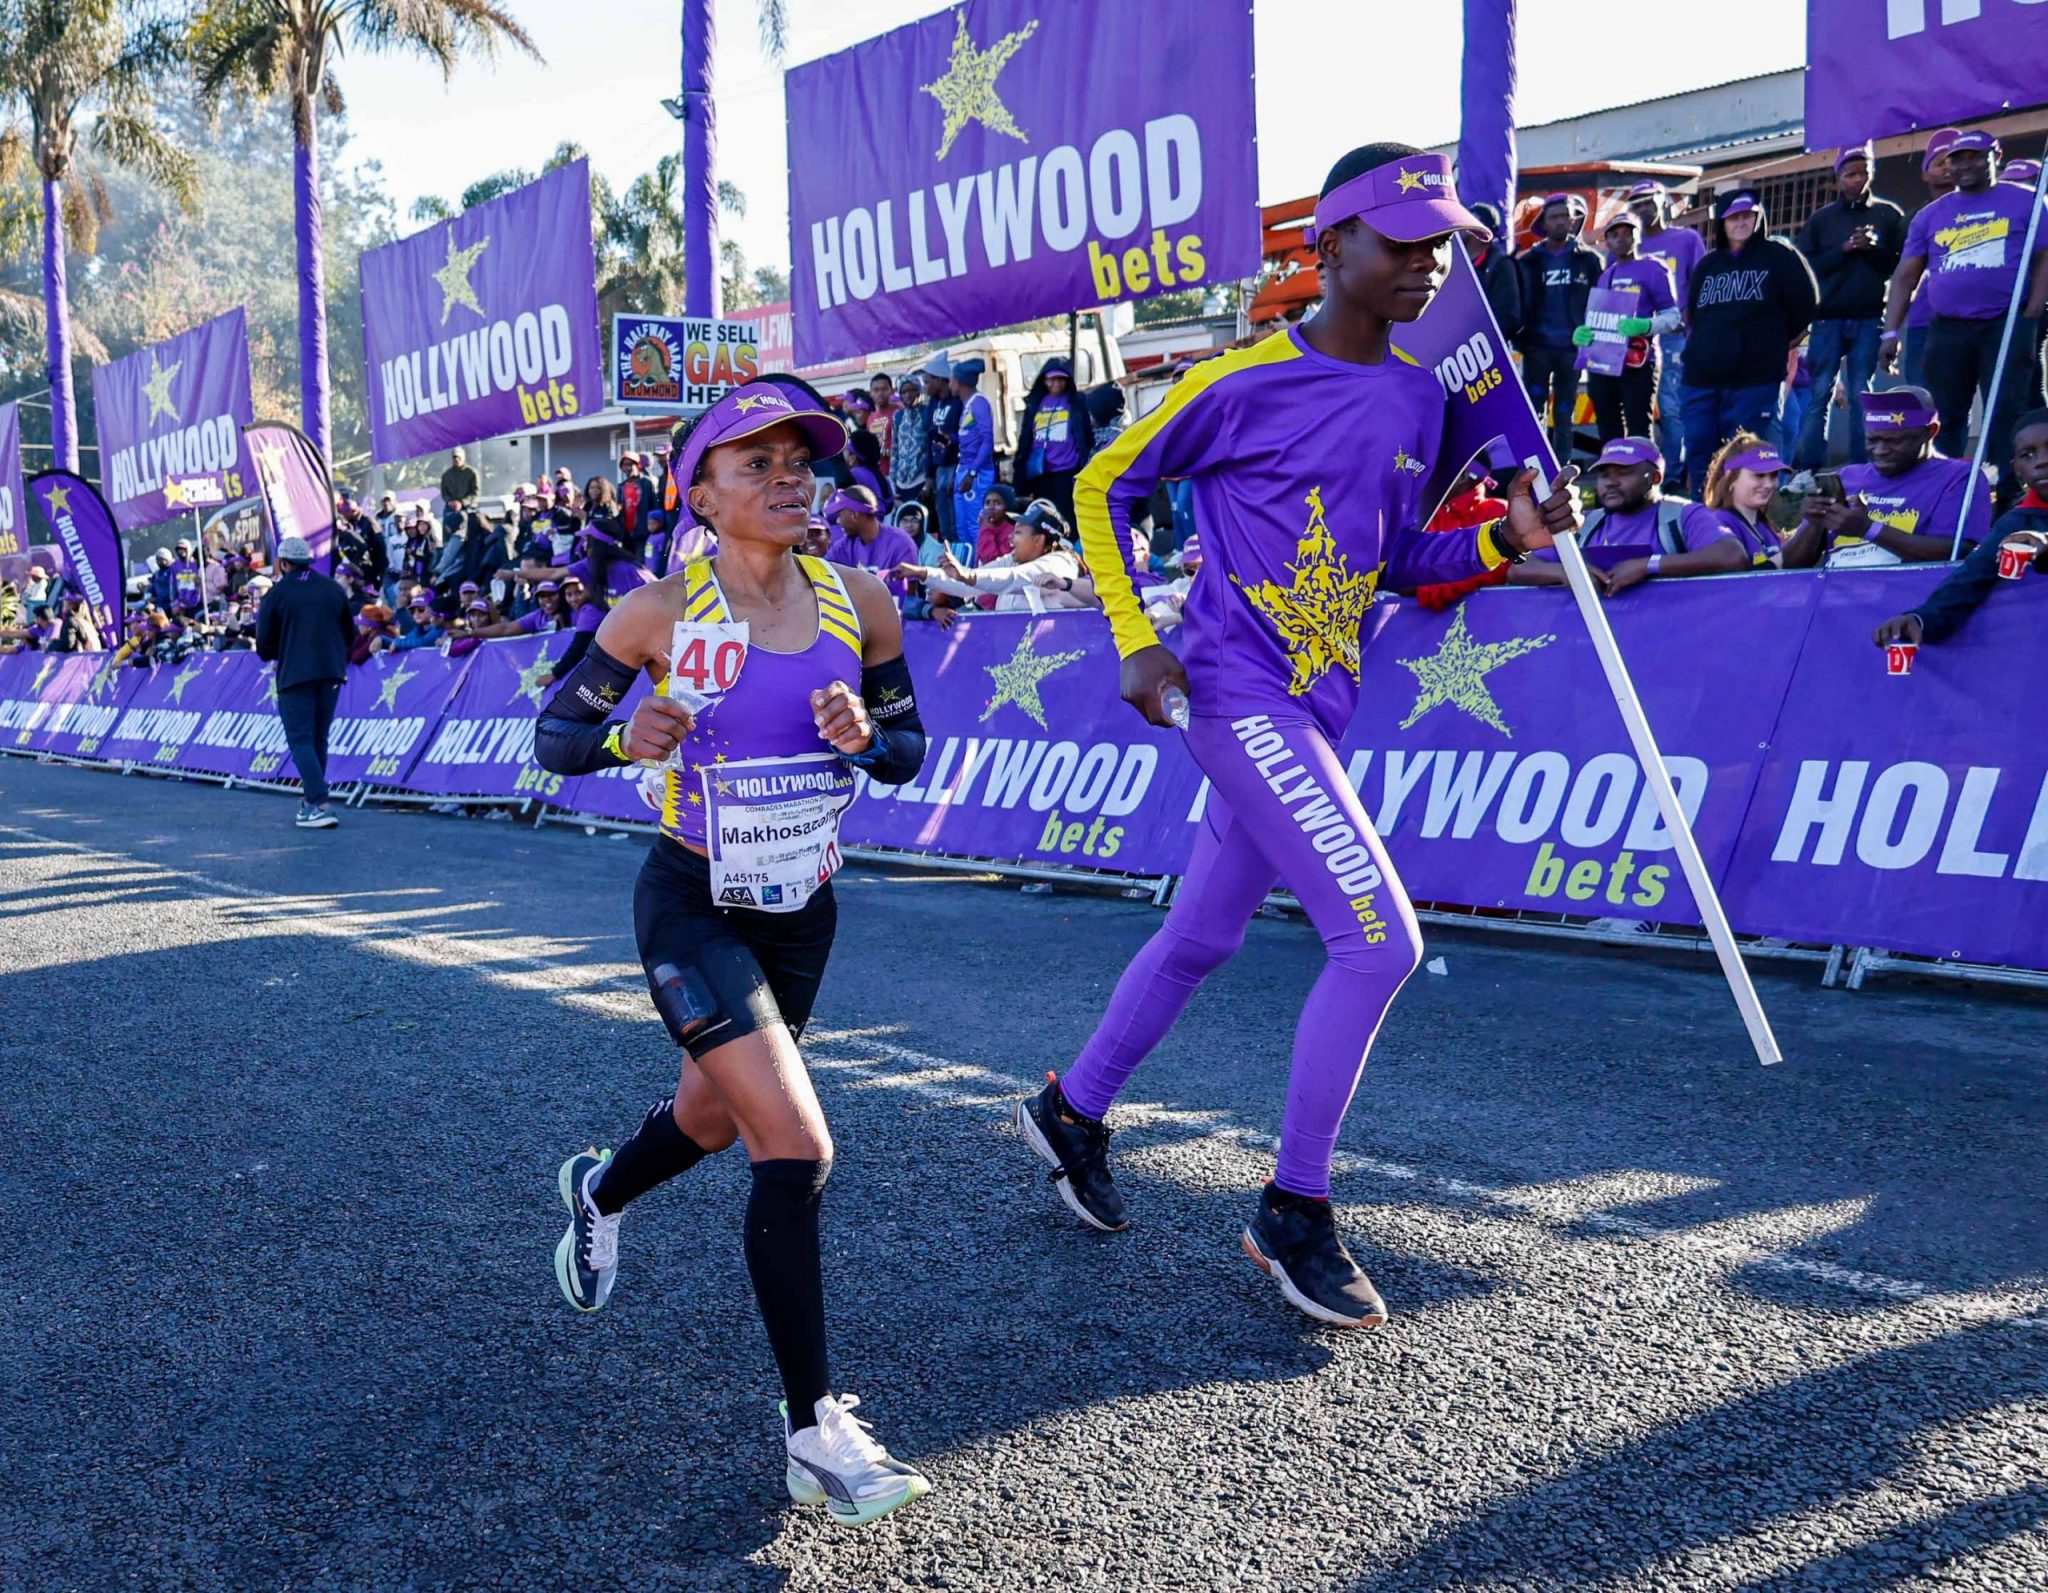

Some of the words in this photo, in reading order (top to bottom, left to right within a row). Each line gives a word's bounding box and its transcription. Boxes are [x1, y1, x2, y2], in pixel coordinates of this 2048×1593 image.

[1423, 173, 1454, 187] HOLL
[811, 114, 1203, 310] HOLLYWOOD
[1087, 229, 1206, 300] bets
[624, 323, 673, 351] HALFWAY
[686, 322, 711, 342] WE
[717, 324, 758, 344] SELL
[380, 304, 573, 426] HOLLYWOOD
[620, 352, 633, 379] THE
[667, 341, 682, 382] MARK
[685, 342, 757, 386] GAS
[516, 378, 579, 426] bets
[624, 382, 679, 398] DRUMMOND
[686, 385, 733, 405] HE
[1464, 367, 1503, 404] bets
[111, 413, 239, 503] HOLLYWOOD
[222, 470, 244, 499] ts
[56, 514, 105, 606] HOLLYWOOD
[676, 638, 746, 693] 40
[112, 708, 201, 745] HOLLYWOOD
[193, 710, 289, 754] HOLLYWOO
[327, 716, 425, 757] OLLYWOOD
[425, 719, 537, 766] HOLLYWO
[249, 751, 280, 773] bets
[365, 755, 401, 777] bets
[513, 763, 564, 797] bets
[852, 736, 1158, 817] LLYWOOD
[735, 771, 834, 799] HOLLYWOOD
[834, 774, 853, 789] bets
[745, 803, 783, 813] COMRADES
[783, 798, 819, 810] MARATHON
[1770, 760, 2048, 882] HOL
[1036, 809, 1126, 859] bets
[1230, 714, 1382, 896] HOLLYWOOD
[1349, 894, 1388, 945] bets
[723, 872, 769, 884] A45175
[791, 886, 797, 899] 1
[1524, 842, 1671, 908] bets
[723, 889, 752, 901] ASA
